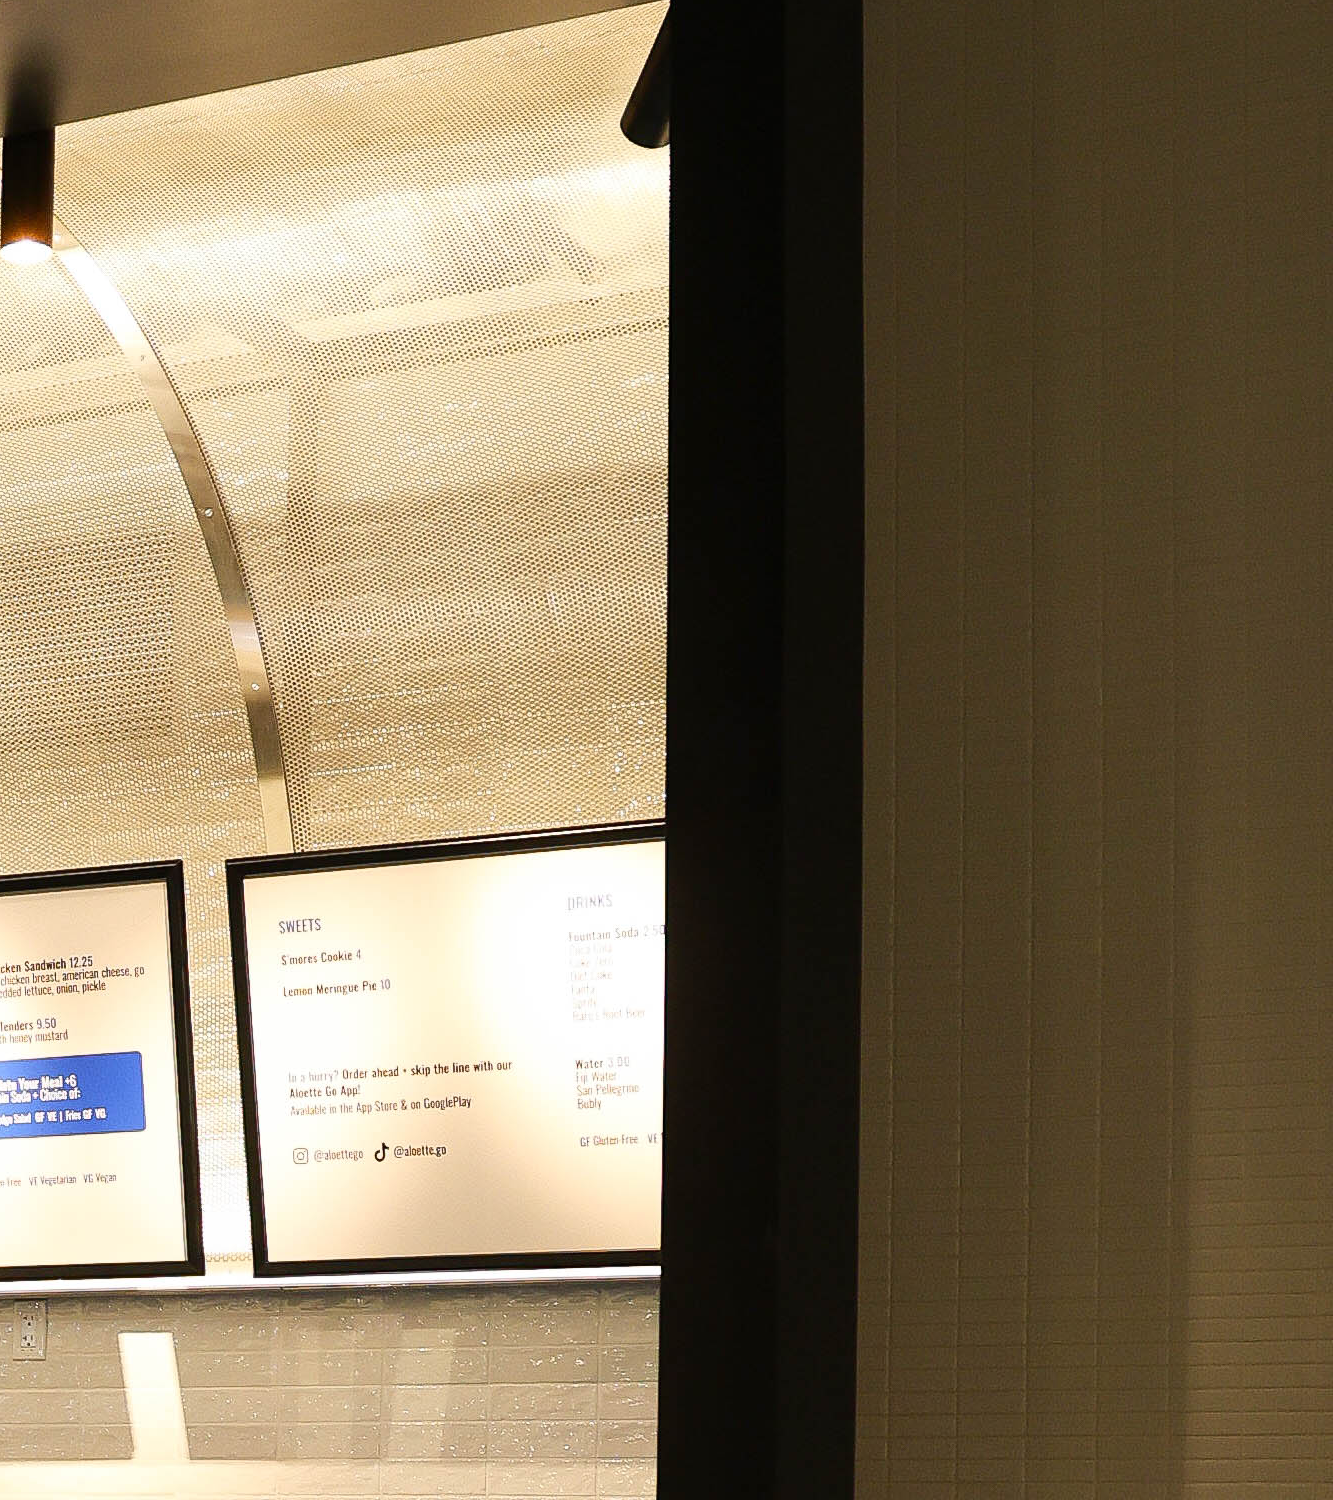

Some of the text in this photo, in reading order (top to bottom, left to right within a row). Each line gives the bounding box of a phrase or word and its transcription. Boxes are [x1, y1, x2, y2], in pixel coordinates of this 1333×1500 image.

[567, 893, 613, 912] DRINKS
[278, 918, 322, 935] SWEETS
[568, 927, 639, 942] Fountain Soda
[24, 957, 67, 972] Sandwich
[68, 955, 93, 968] 12.25
[281, 948, 361, 966] S'mores Cookie 4
[0, 966, 145, 987] chicken american go
[24, 984, 55, 997] lettuce,
[56, 982, 81, 995] onion,
[82, 980, 106, 995] pickle
[283, 978, 391, 998] Lemon Meringue Pie 10
[0, 1020, 34, 1032] Tenders
[36, 1017, 57, 1029] 9.50
[34, 1029, 69, 1042] mustard
[288, 1072, 298, 1083] In
[300, 1073, 306, 1082] a
[342, 1068, 368, 1080] Order
[371, 1066, 399, 1078] ahead
[410, 1064, 431, 1078] skip
[433, 1062, 450, 1075] the
[452, 1062, 471, 1074] line
[473, 1060, 494, 1073] with
[496, 1061, 513, 1071] our
[574, 1059, 604, 1070] Water
[18, 1075, 63, 1090] Your Meal
[592, 1071, 617, 1082] Water
[10, 1088, 82, 1104] Soda Choice of:
[289, 1083, 361, 1099] Aloette Go App!
[576, 1083, 640, 1097] San Pellegrino
[290, 1096, 472, 1116] Available in the App Store & on GooglePlay
[577, 1097, 602, 1111] Bubly
[47, 1110, 81, 1122] VE Fries
[580, 1132, 657, 1148] GF Gluten-Free VE
[40, 1173, 117, 1186] Vegetarian Vegan
